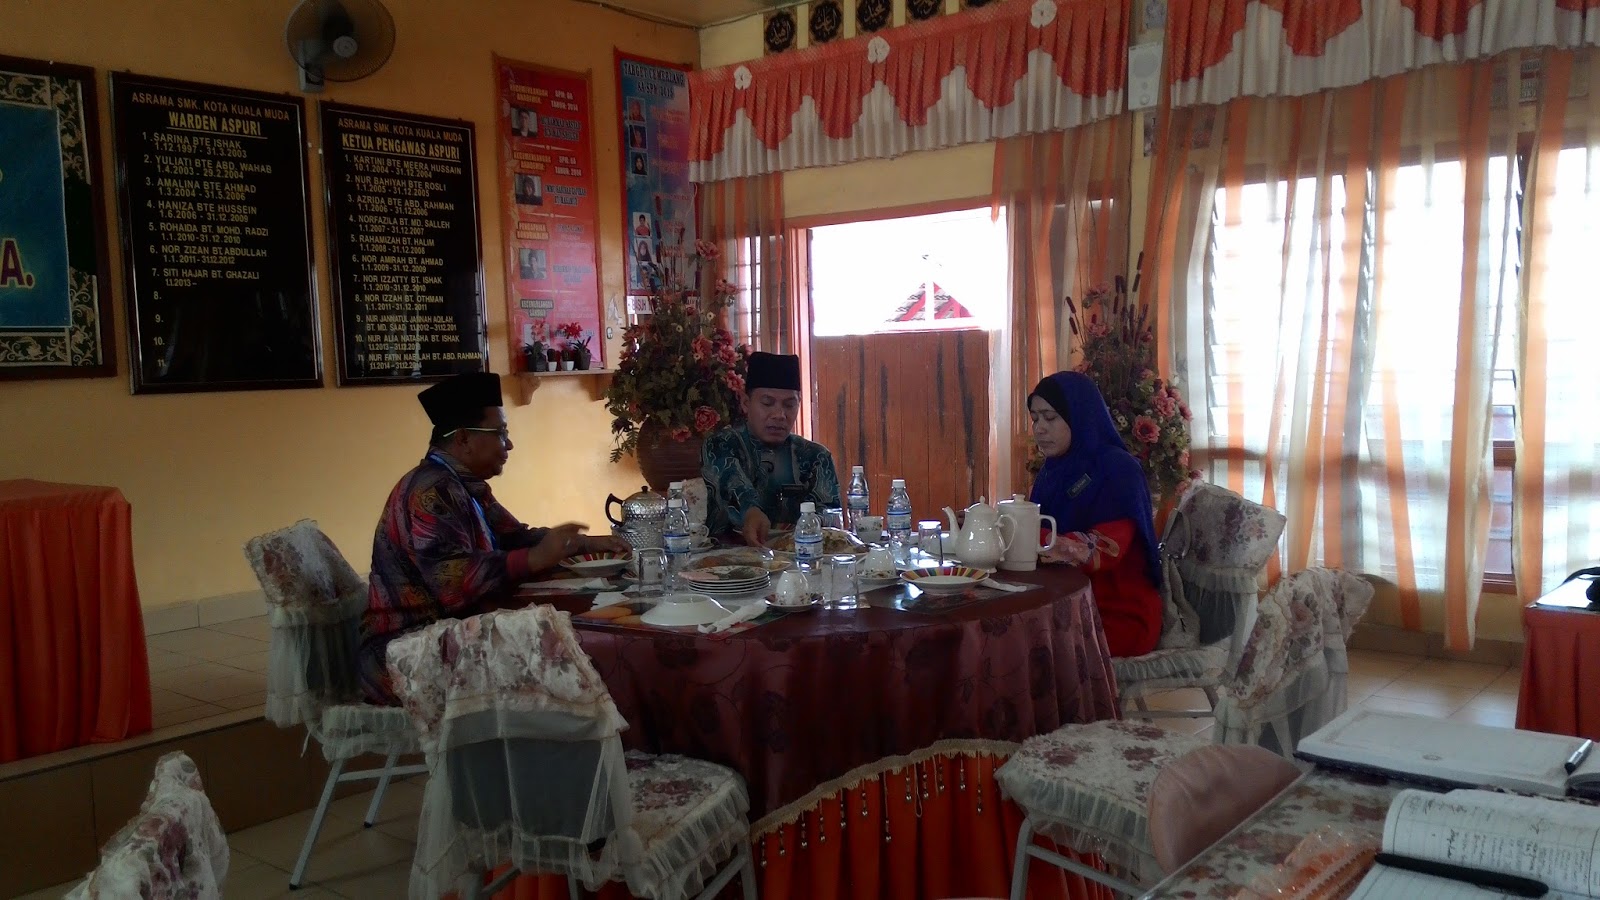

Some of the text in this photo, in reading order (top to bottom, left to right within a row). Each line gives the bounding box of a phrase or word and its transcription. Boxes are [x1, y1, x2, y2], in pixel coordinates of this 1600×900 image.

[624, 63, 685, 87] TARGET CEMERLANG
[132, 92, 289, 120] ASRAMA SMK. KOTA KUALA MUDA
[169, 112, 261, 135] WARDEN ASPURI
[338, 118, 371, 131] ASRAMA
[393, 126, 414, 135] KOTA
[416, 128, 441, 139] KUALA
[444, 131, 463, 142] MUDA
[154, 132, 190, 145] SARINA
[193, 138, 210, 146] BTE
[214, 138, 241, 149] ISHAK
[342, 134, 459, 159] KETUA PENGAWAS ASPURI
[155, 142, 247, 158] 1.12.1997 31.3.2003
[144, 155, 272, 173] 2. YULIATI BTE ABD. WAHAB
[354, 155, 385, 165] KARTINI
[386, 159, 401, 168] BTE
[404, 160, 429, 171] MEERA
[431, 165, 461, 175] HUSSAIN
[157, 165, 243, 179] 1.4.2003 29.2.2004
[146, 177, 256, 193] 3. AMALINA BTE AHMAD
[355, 175, 371, 184] NUR
[374, 177, 406, 187] BAHIYAH
[425, 182, 446, 190] ROSLI
[356, 184, 386, 193] 1.1.2005
[159, 188, 246, 200] 1.3.2004 31.5.2006
[147, 201, 257, 214] 4. HANIZA BTE HUSSEIN
[357, 195, 386, 204] AZRIDA
[405, 199, 422, 208] ABD.
[424, 201, 454, 210] RAHMAN
[358, 204, 387, 212] 1.1.2006
[160, 210, 248, 222] 1.6.2006 31.12.2009
[358, 215, 397, 225] NORFAZILA
[425, 220, 450, 228] SALLEH
[149, 223, 268, 236] 5. ROHAIDA BT. MOHD. RADZI
[360, 235, 401, 244] RAHAMIZAH
[414, 238, 434, 246] HALIM
[150, 246, 158, 254] 6.
[162, 246, 180, 254] NOR
[184, 246, 209, 255] ZIZAN
[163, 268, 178, 277] SITI
[182, 269, 208, 278] HAJAR
[226, 271, 259, 280] GHAZALI
[154, 292, 162, 300] 8.
[155, 315, 163, 323] 9.
[154, 337, 165, 345] 10.
